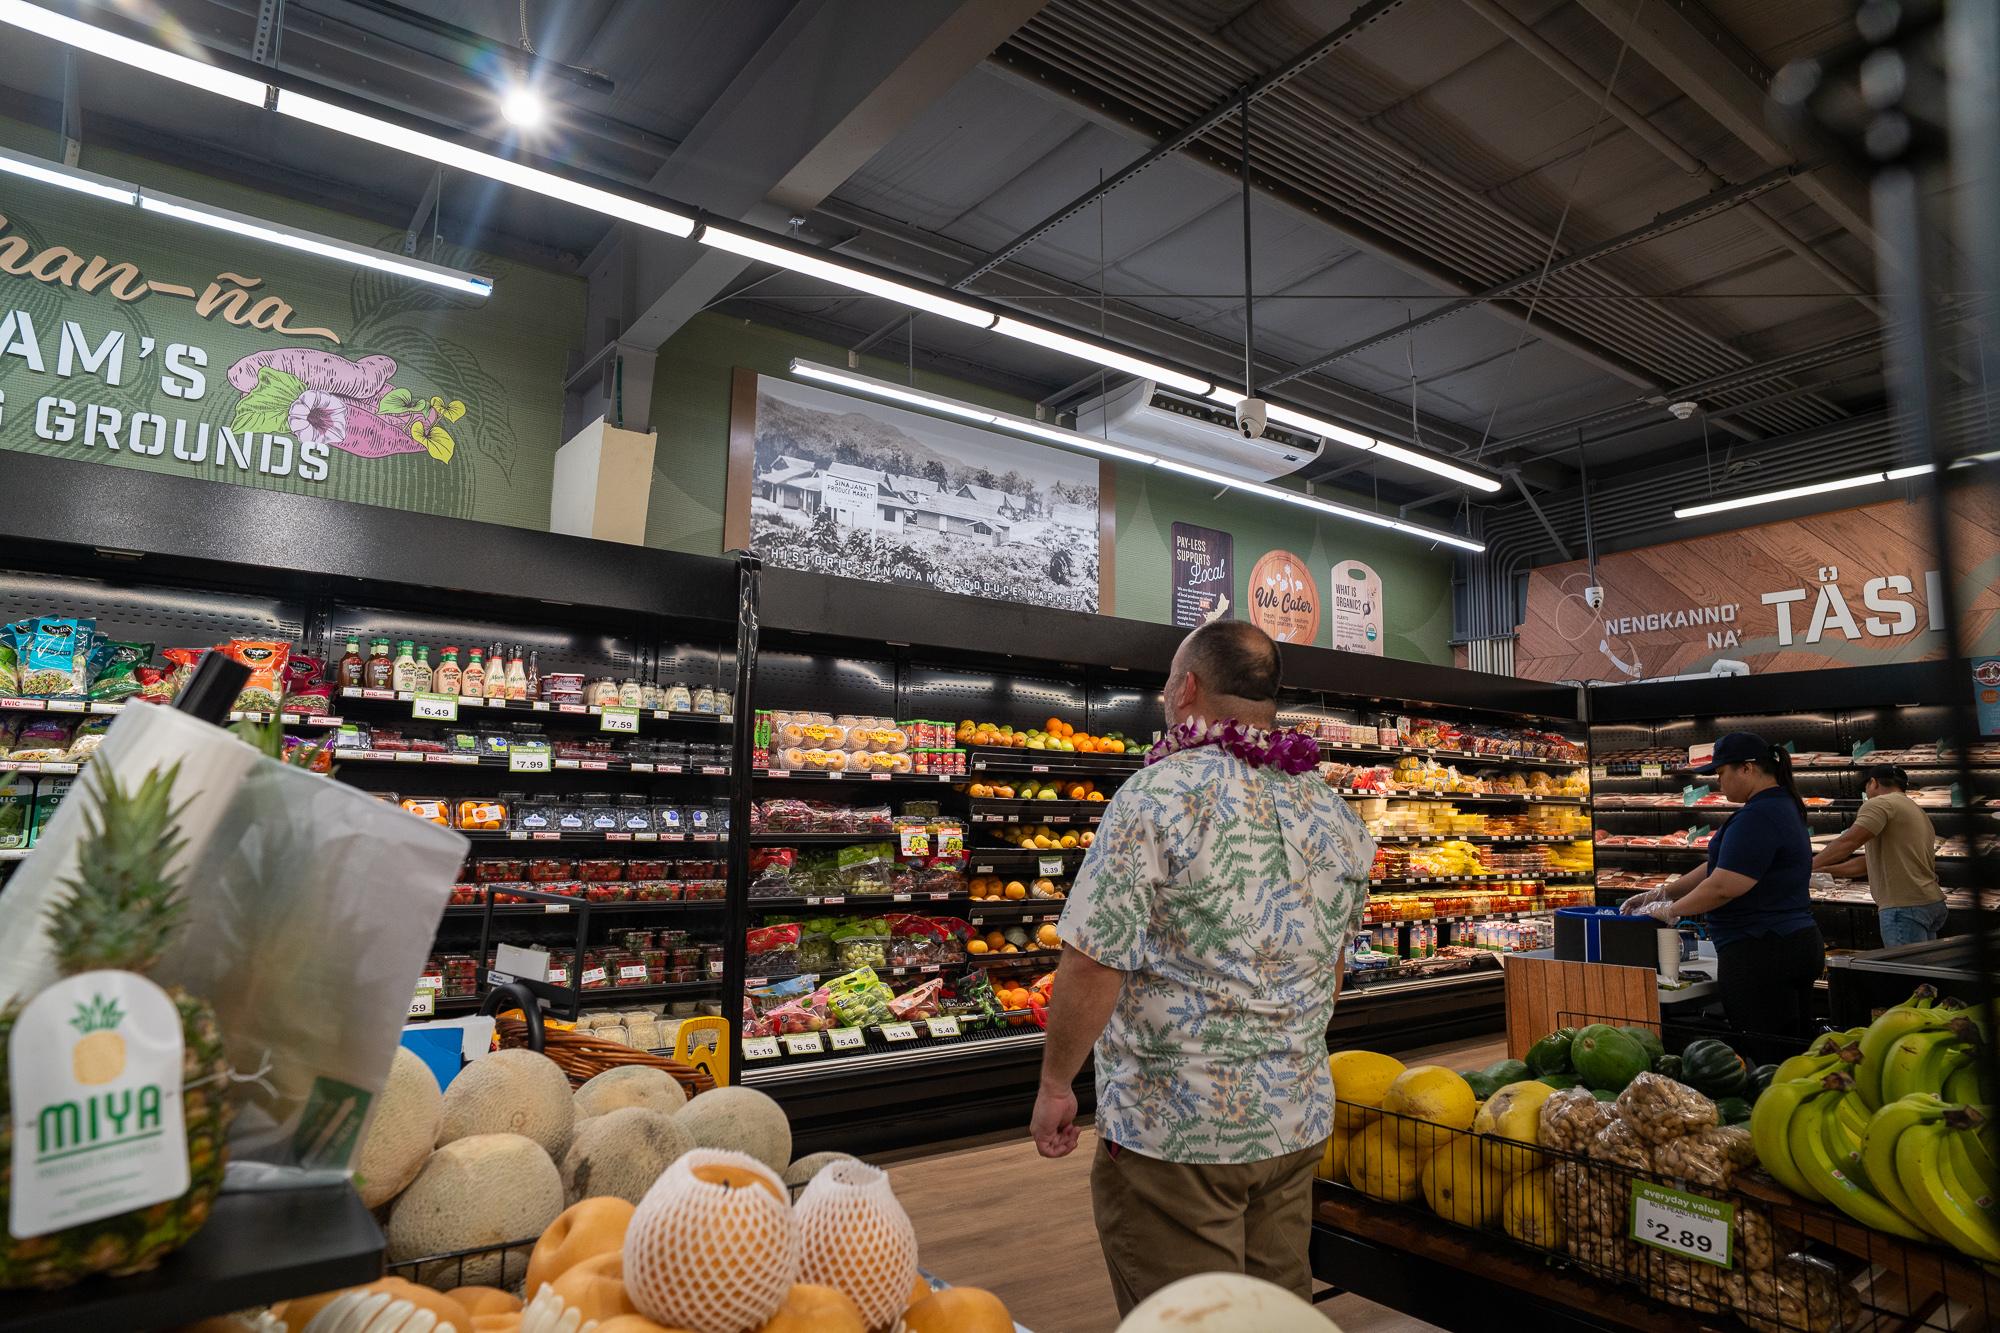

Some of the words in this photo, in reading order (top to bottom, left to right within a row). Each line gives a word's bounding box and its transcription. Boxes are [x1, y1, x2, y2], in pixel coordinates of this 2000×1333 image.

[35, 397, 330, 481] GROUNDS
[1176, 536, 1206, 552] PAY-LESS
[1176, 548, 1211, 566] SUPPORTS
[770, 549, 854, 571] HISTORIC
[863, 561, 945, 584] SINAJANA
[953, 577, 1019, 597] PRODUCE
[1026, 590, 1082, 606] MARKET
[1188, 558, 1226, 586] Local
[1335, 584, 1350, 596] WHAT
[1351, 587, 1357, 597] IS
[1255, 586, 1279, 608] We
[1281, 592, 1312, 614] Cater
[1335, 596, 1362, 611] ORGANIC?
[1707, 630, 1742, 650] NA'
[420, 706, 449, 717] $6.49
[607, 719, 632, 729] $7.59
[516, 760, 544, 769] $7.99
[408, 1004, 426, 1013] .59
[793, 1043, 817, 1051] $6.59
[836, 1038, 859, 1046] $5.49
[749, 1047, 774, 1056] $5.19
[38, 1085, 162, 1152] MIYA
[1643, 1188, 1690, 1208] everyday
[1691, 1201, 1721, 1216] value
[1649, 1201, 1666, 1212] NUTS
[1666, 1206, 1697, 1219] PEANUTS
[1646, 1218, 1713, 1253] $2.89
